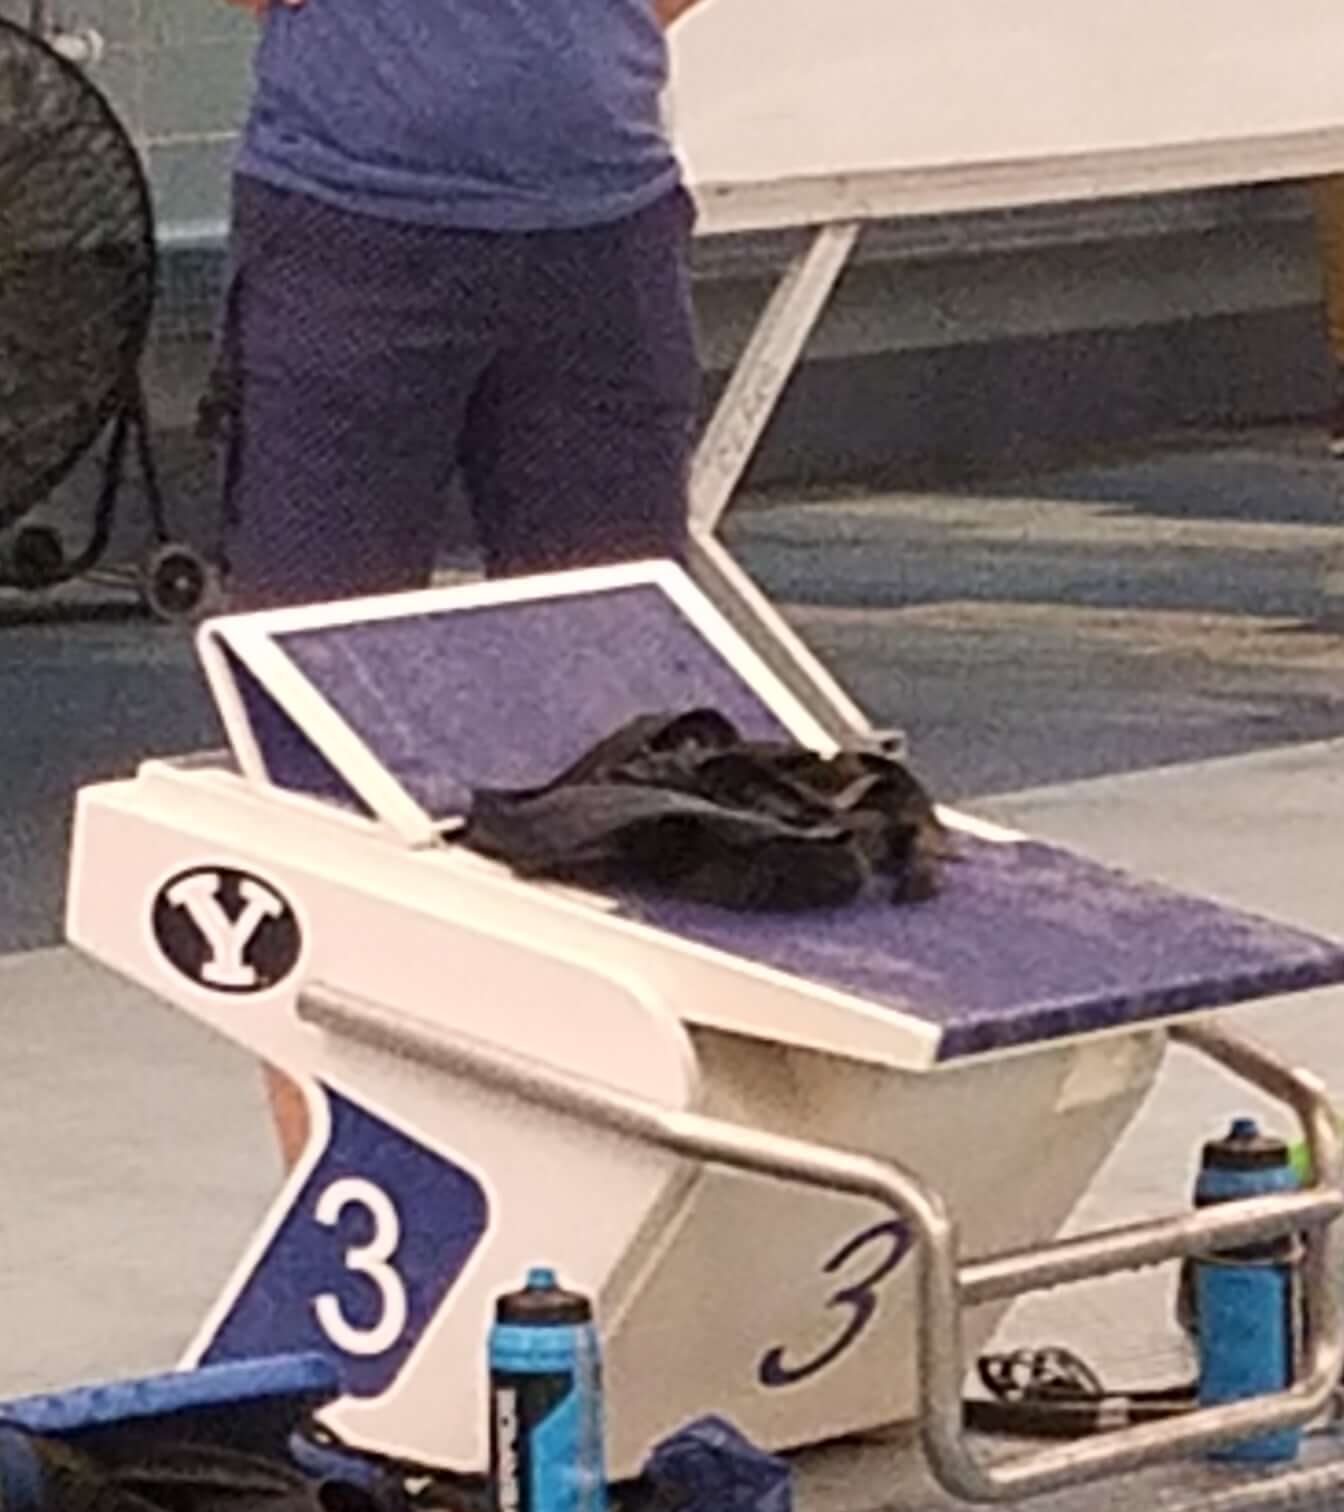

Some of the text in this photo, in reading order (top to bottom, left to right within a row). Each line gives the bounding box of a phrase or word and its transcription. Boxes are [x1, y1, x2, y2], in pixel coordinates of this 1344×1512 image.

[166, 875, 284, 987] Y
[312, 1179, 408, 1355] 3
[757, 1220, 912, 1388] 3
